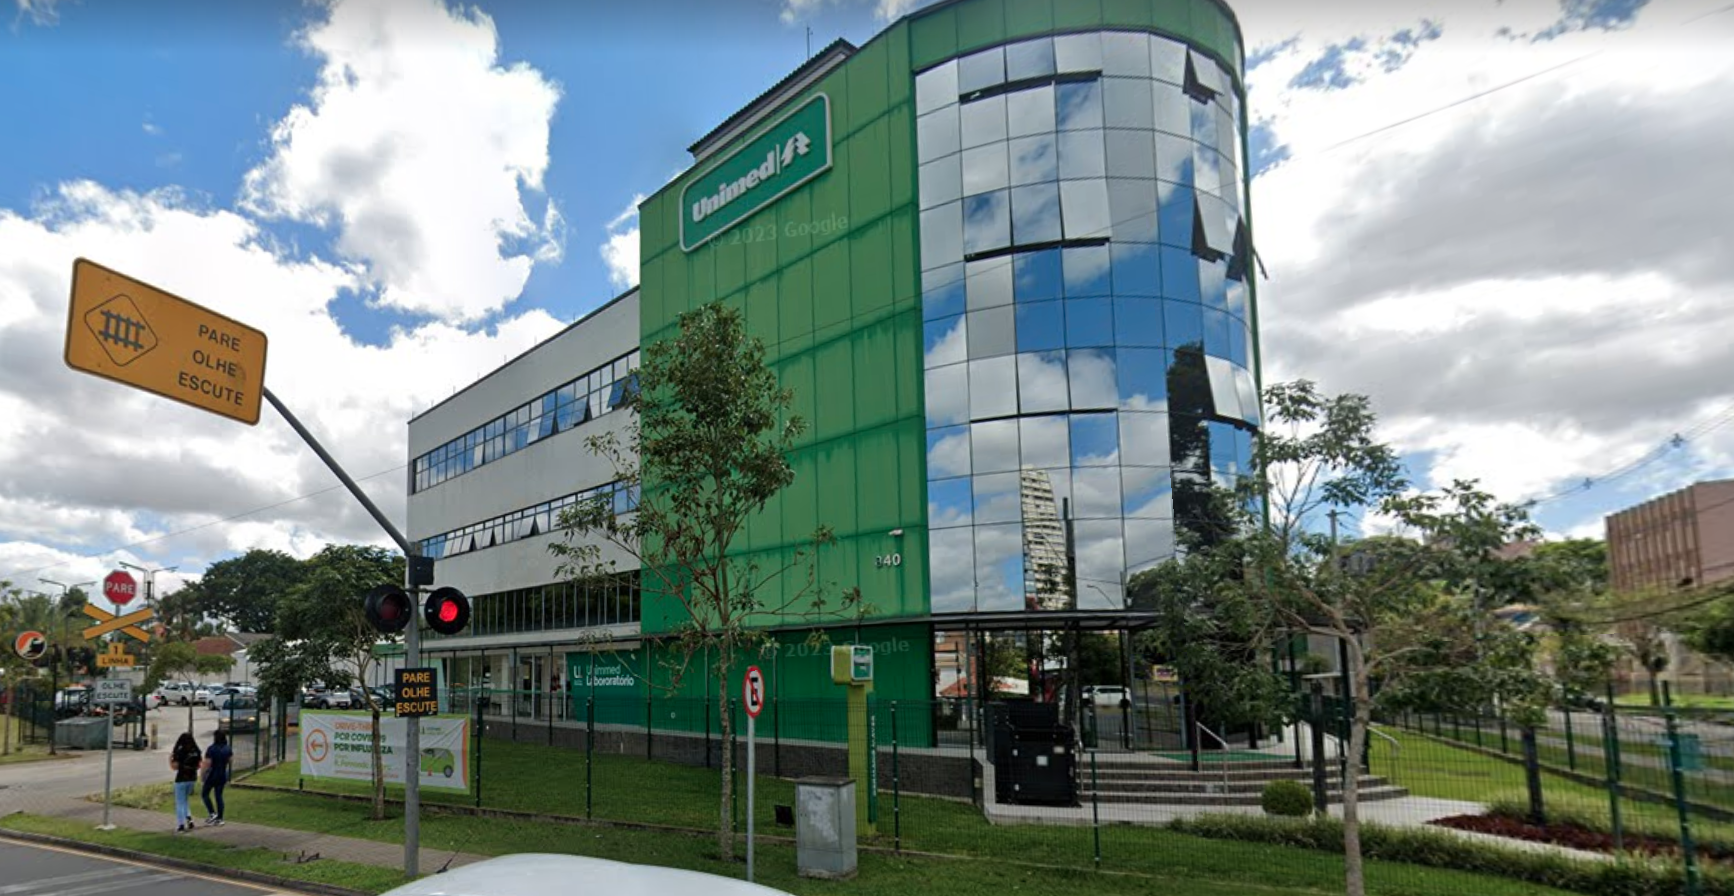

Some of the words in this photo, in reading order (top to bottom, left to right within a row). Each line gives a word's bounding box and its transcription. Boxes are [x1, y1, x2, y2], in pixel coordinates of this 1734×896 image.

[692, 150, 775, 222] Unimed
[198, 324, 241, 352] PARE
[192, 349, 238, 378] OLHE
[178, 370, 244, 406] ESCUTE
[105, 581, 135, 594] PARE
[113, 645, 119, 655] 1
[102, 655, 129, 665] LINHA
[402, 672, 431, 683] PARE
[101, 681, 127, 691] OLHE
[97, 690, 129, 699] ESCUTE
[402, 687, 431, 698] OLHE
[395, 701, 438, 714] ESCUTE
[334, 743, 350, 753] PCR
